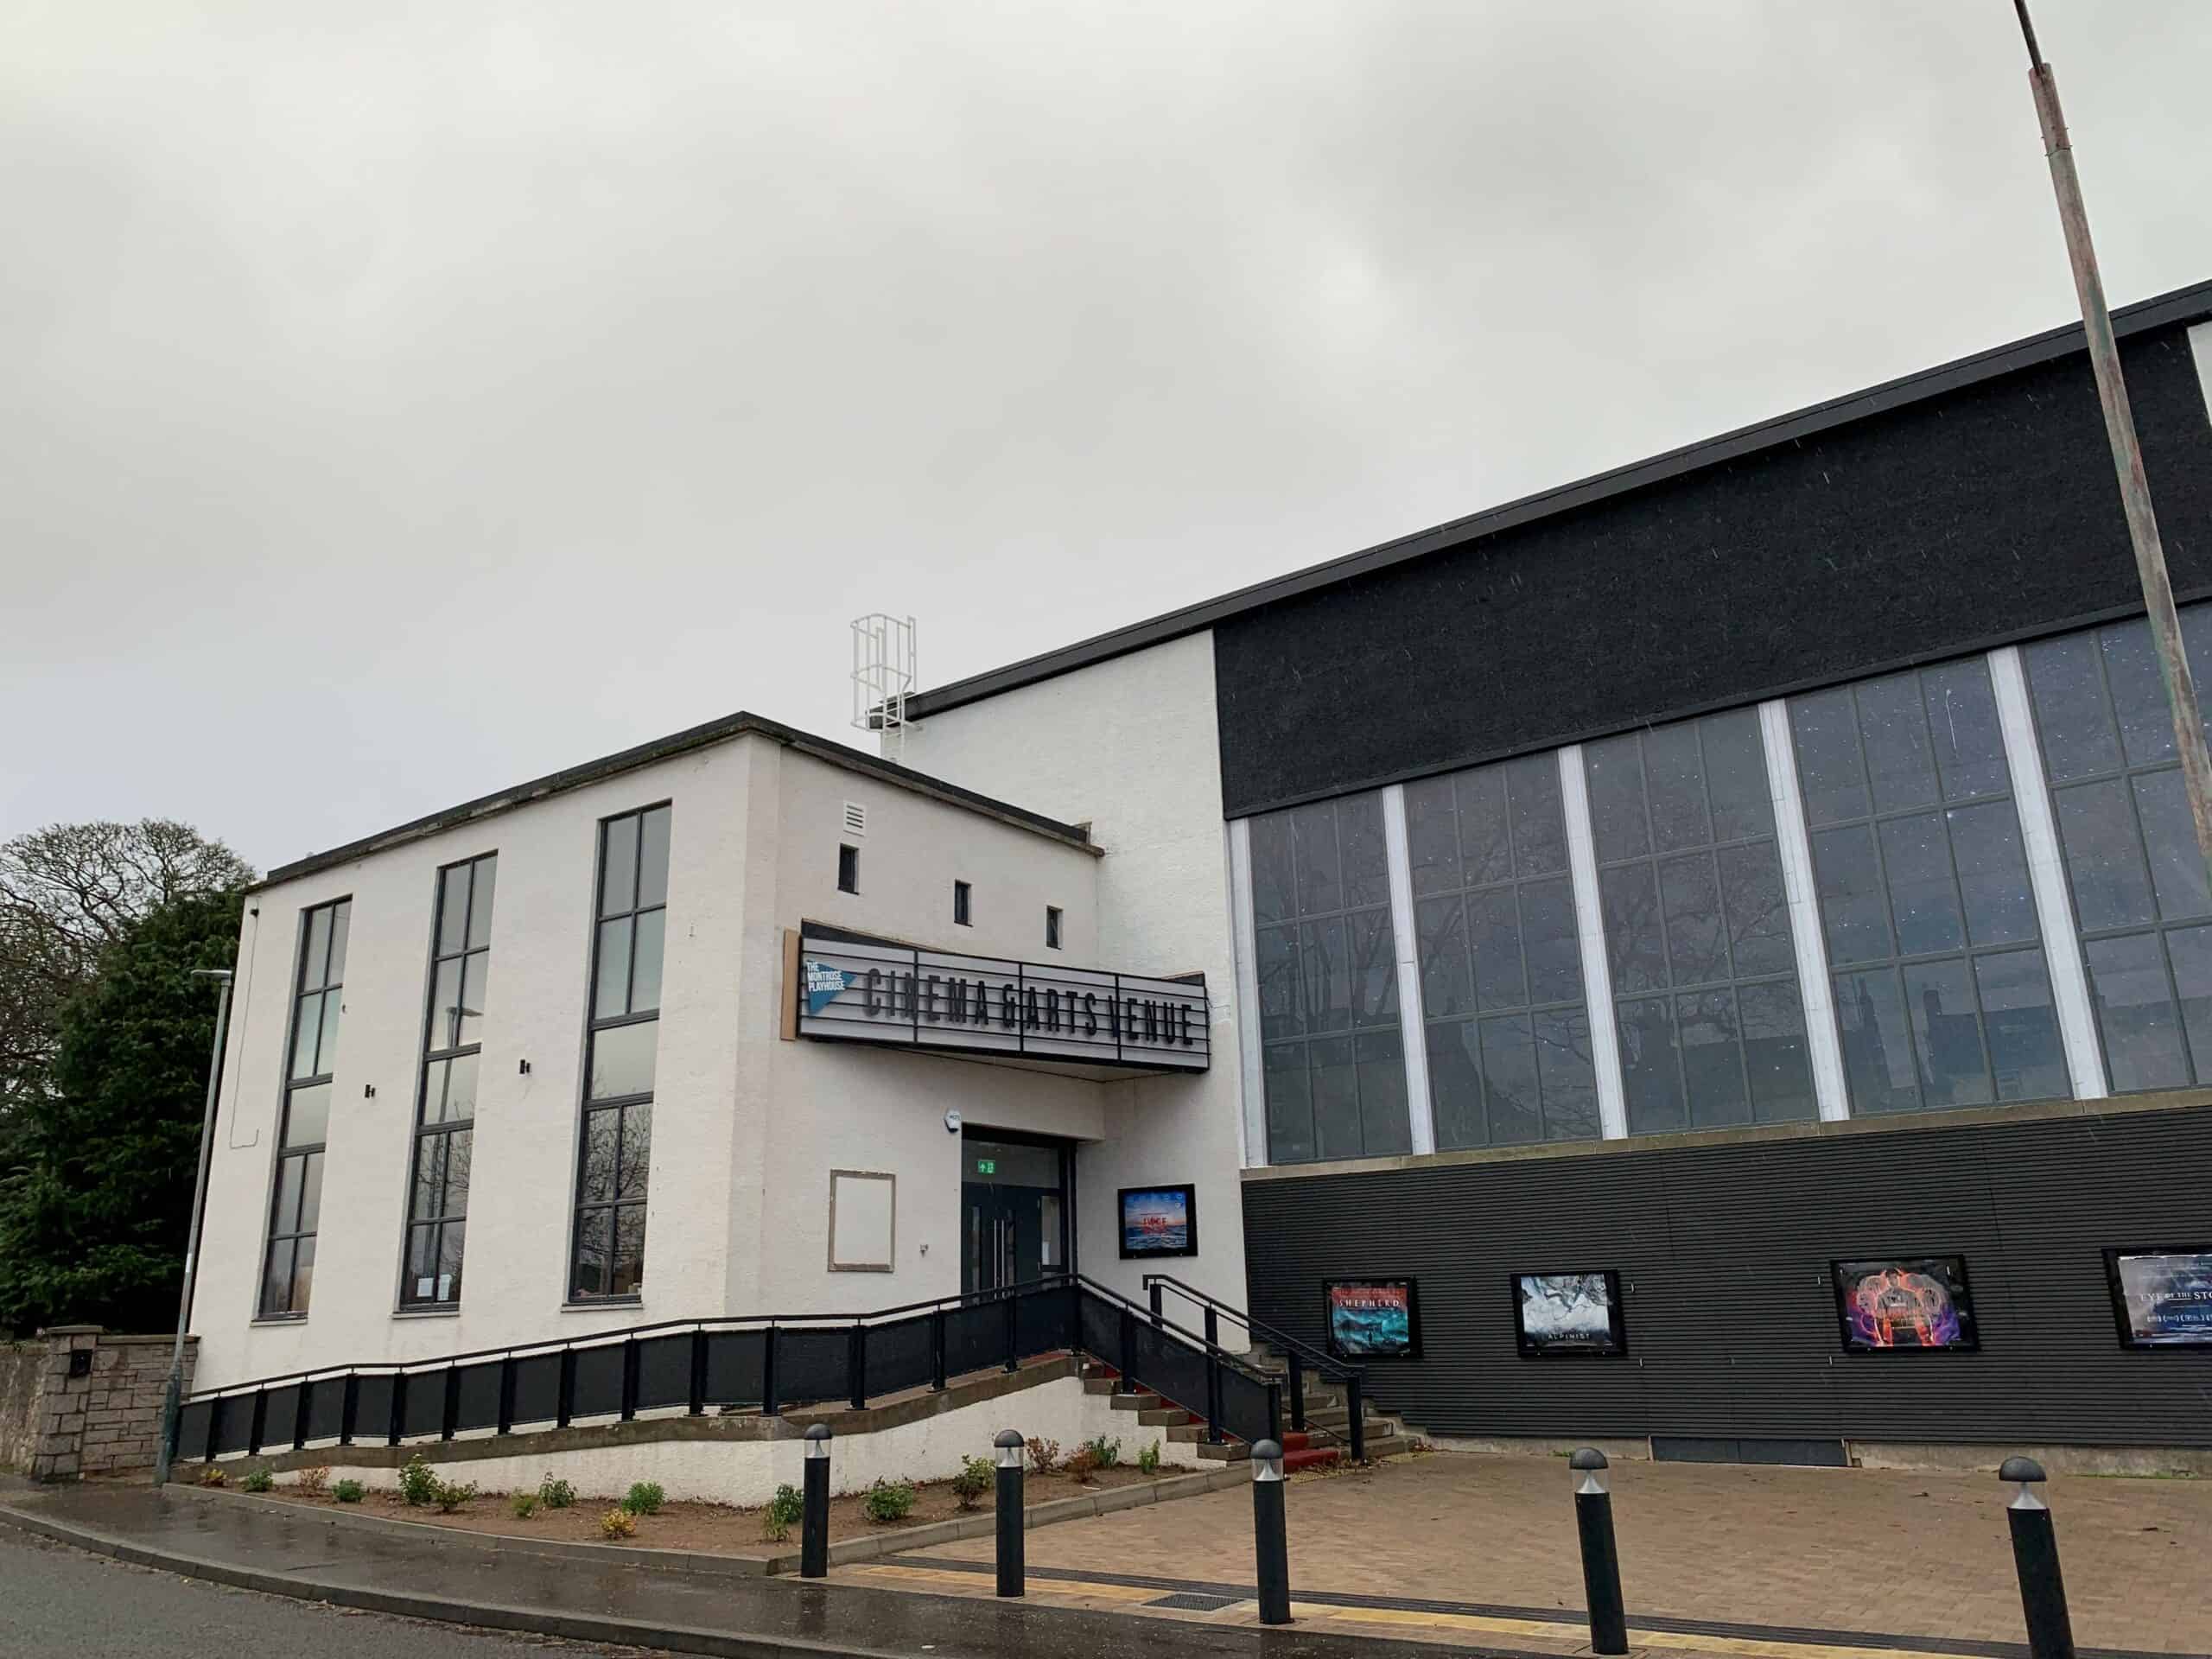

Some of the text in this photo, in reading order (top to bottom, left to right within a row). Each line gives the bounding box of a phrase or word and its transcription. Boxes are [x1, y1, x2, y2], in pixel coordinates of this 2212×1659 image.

[806, 962, 820, 972] THE
[807, 970, 843, 982] MONTROSE
[808, 980, 846, 992] PLAYHOUSE
[865, 968, 1194, 1046] CINEMA & ARTS VENUE
